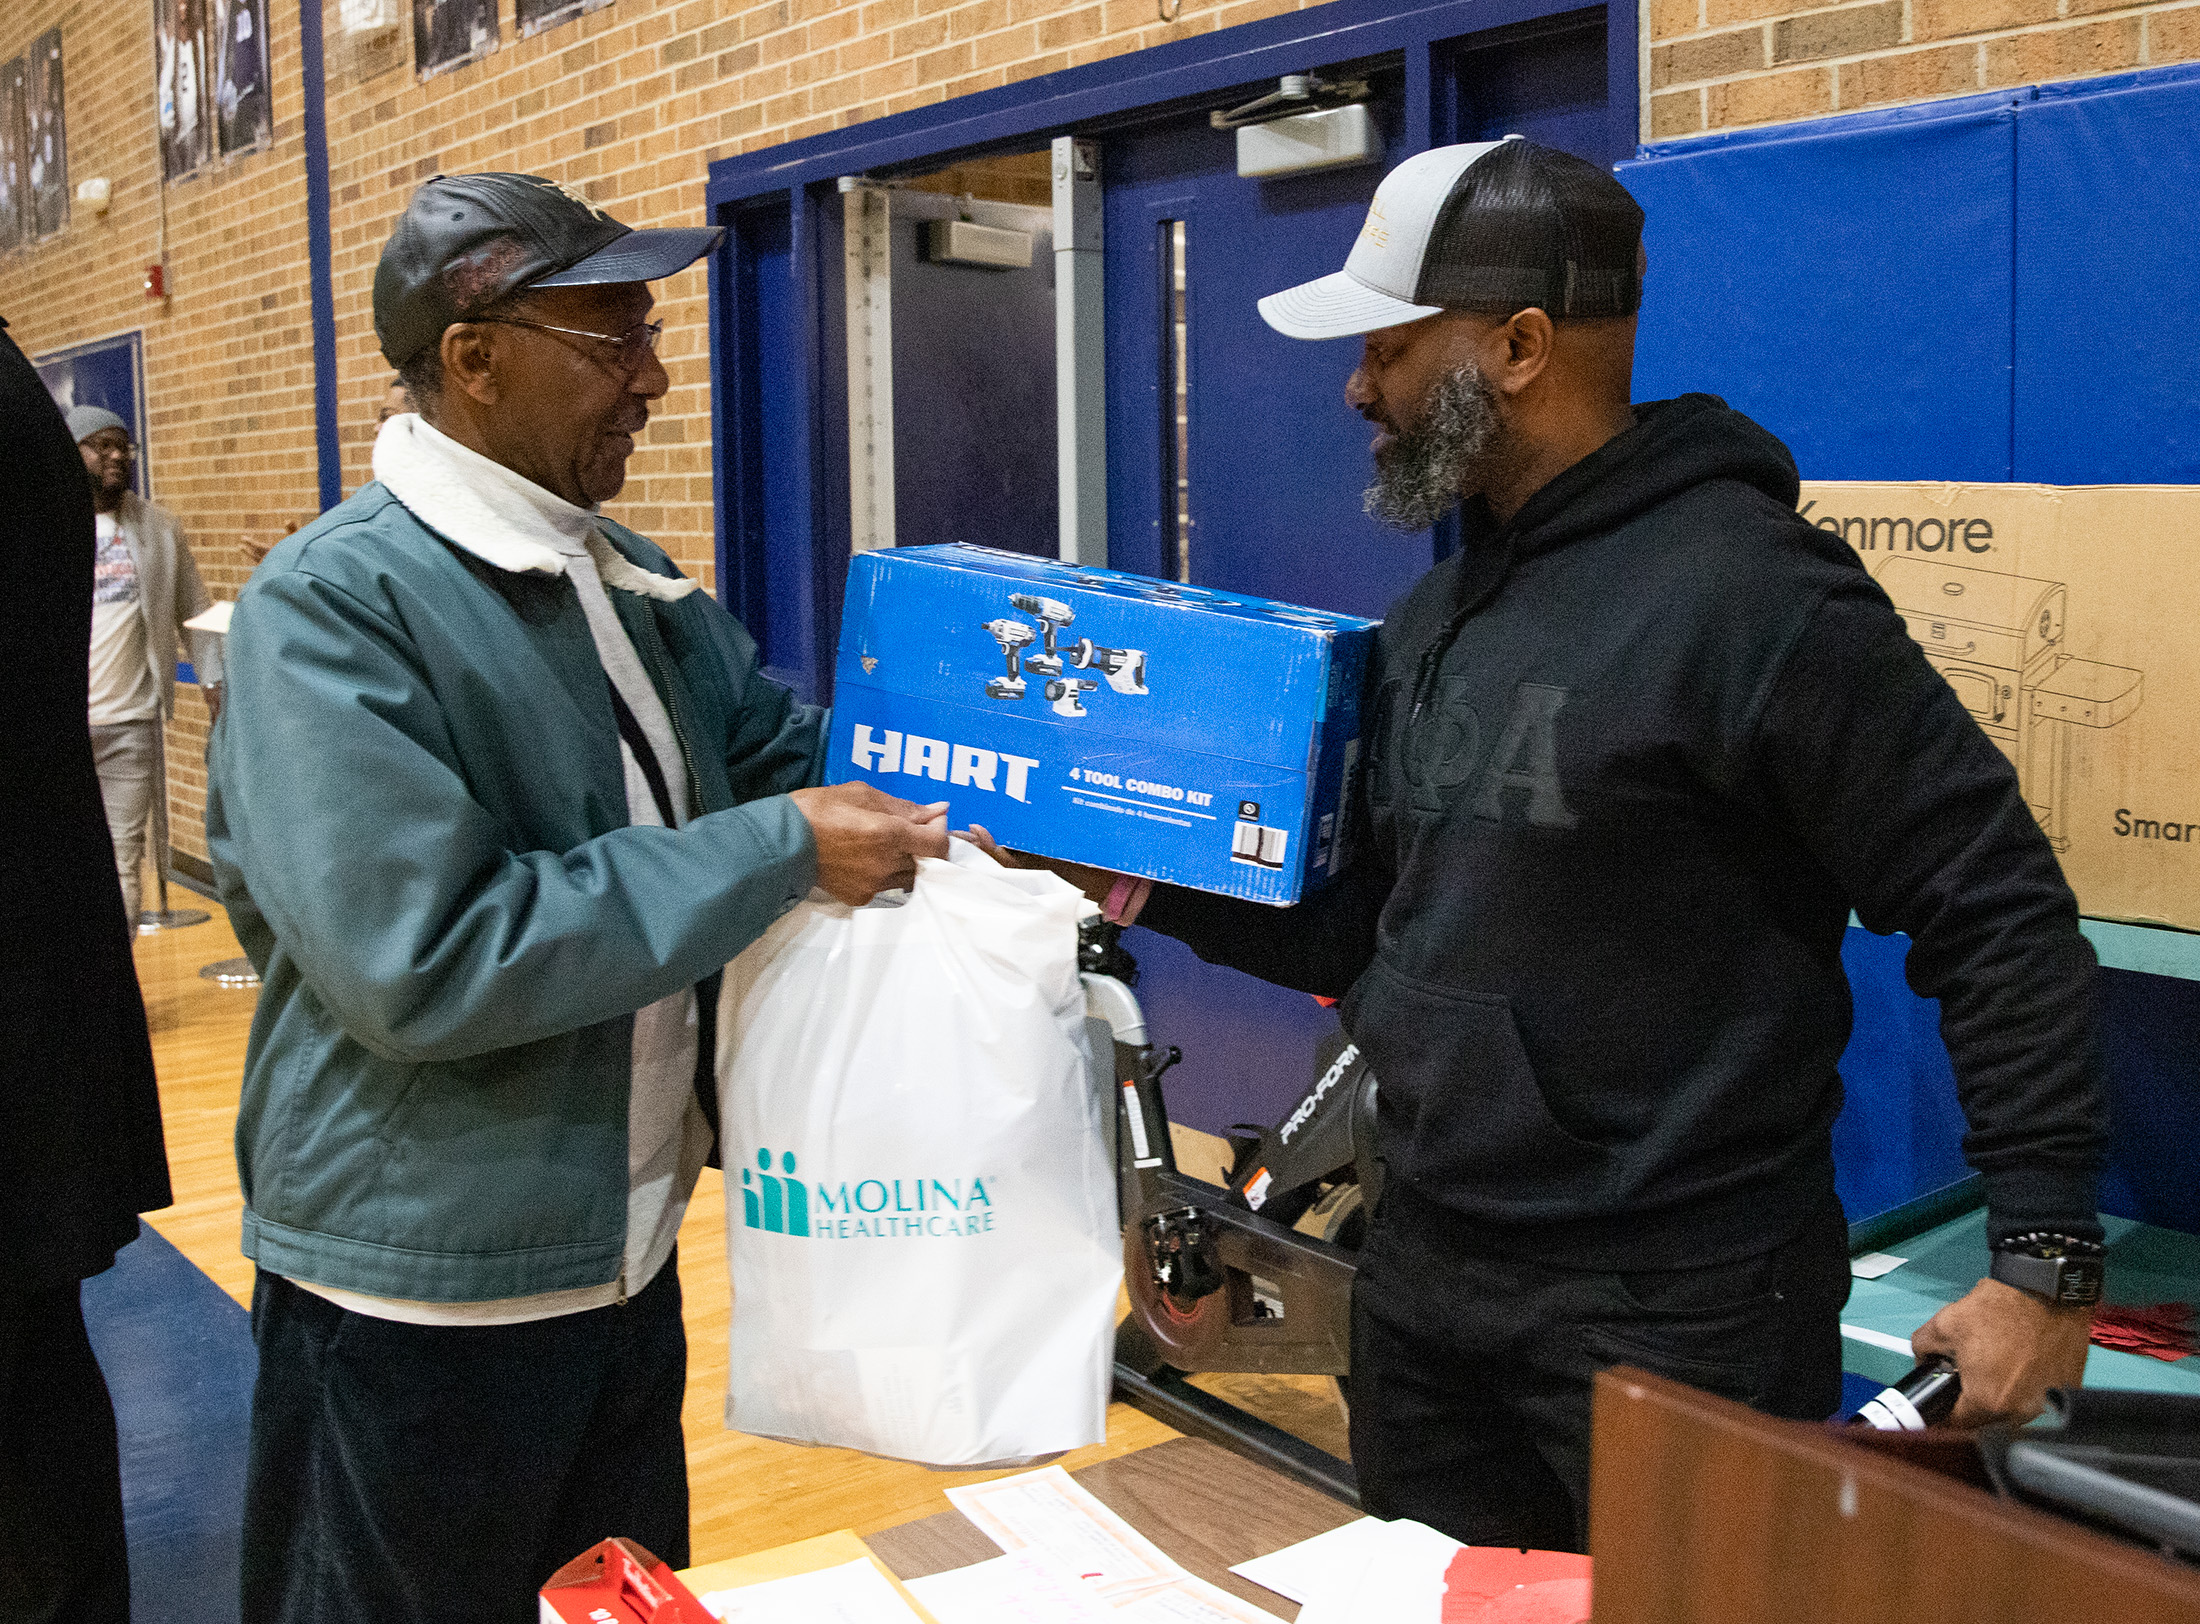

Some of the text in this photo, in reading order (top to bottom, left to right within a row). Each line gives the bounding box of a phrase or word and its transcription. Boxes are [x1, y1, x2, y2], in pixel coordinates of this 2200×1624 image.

[1799, 500, 1994, 554] enmore
[851, 723, 1040, 804] HART
[1069, 767, 1213, 807] 4 TOOL COMBO KIT
[2112, 808, 2200, 843] Smar
[814, 1177, 992, 1214] MOLINA
[816, 1211, 997, 1239] HEALTHCARE
